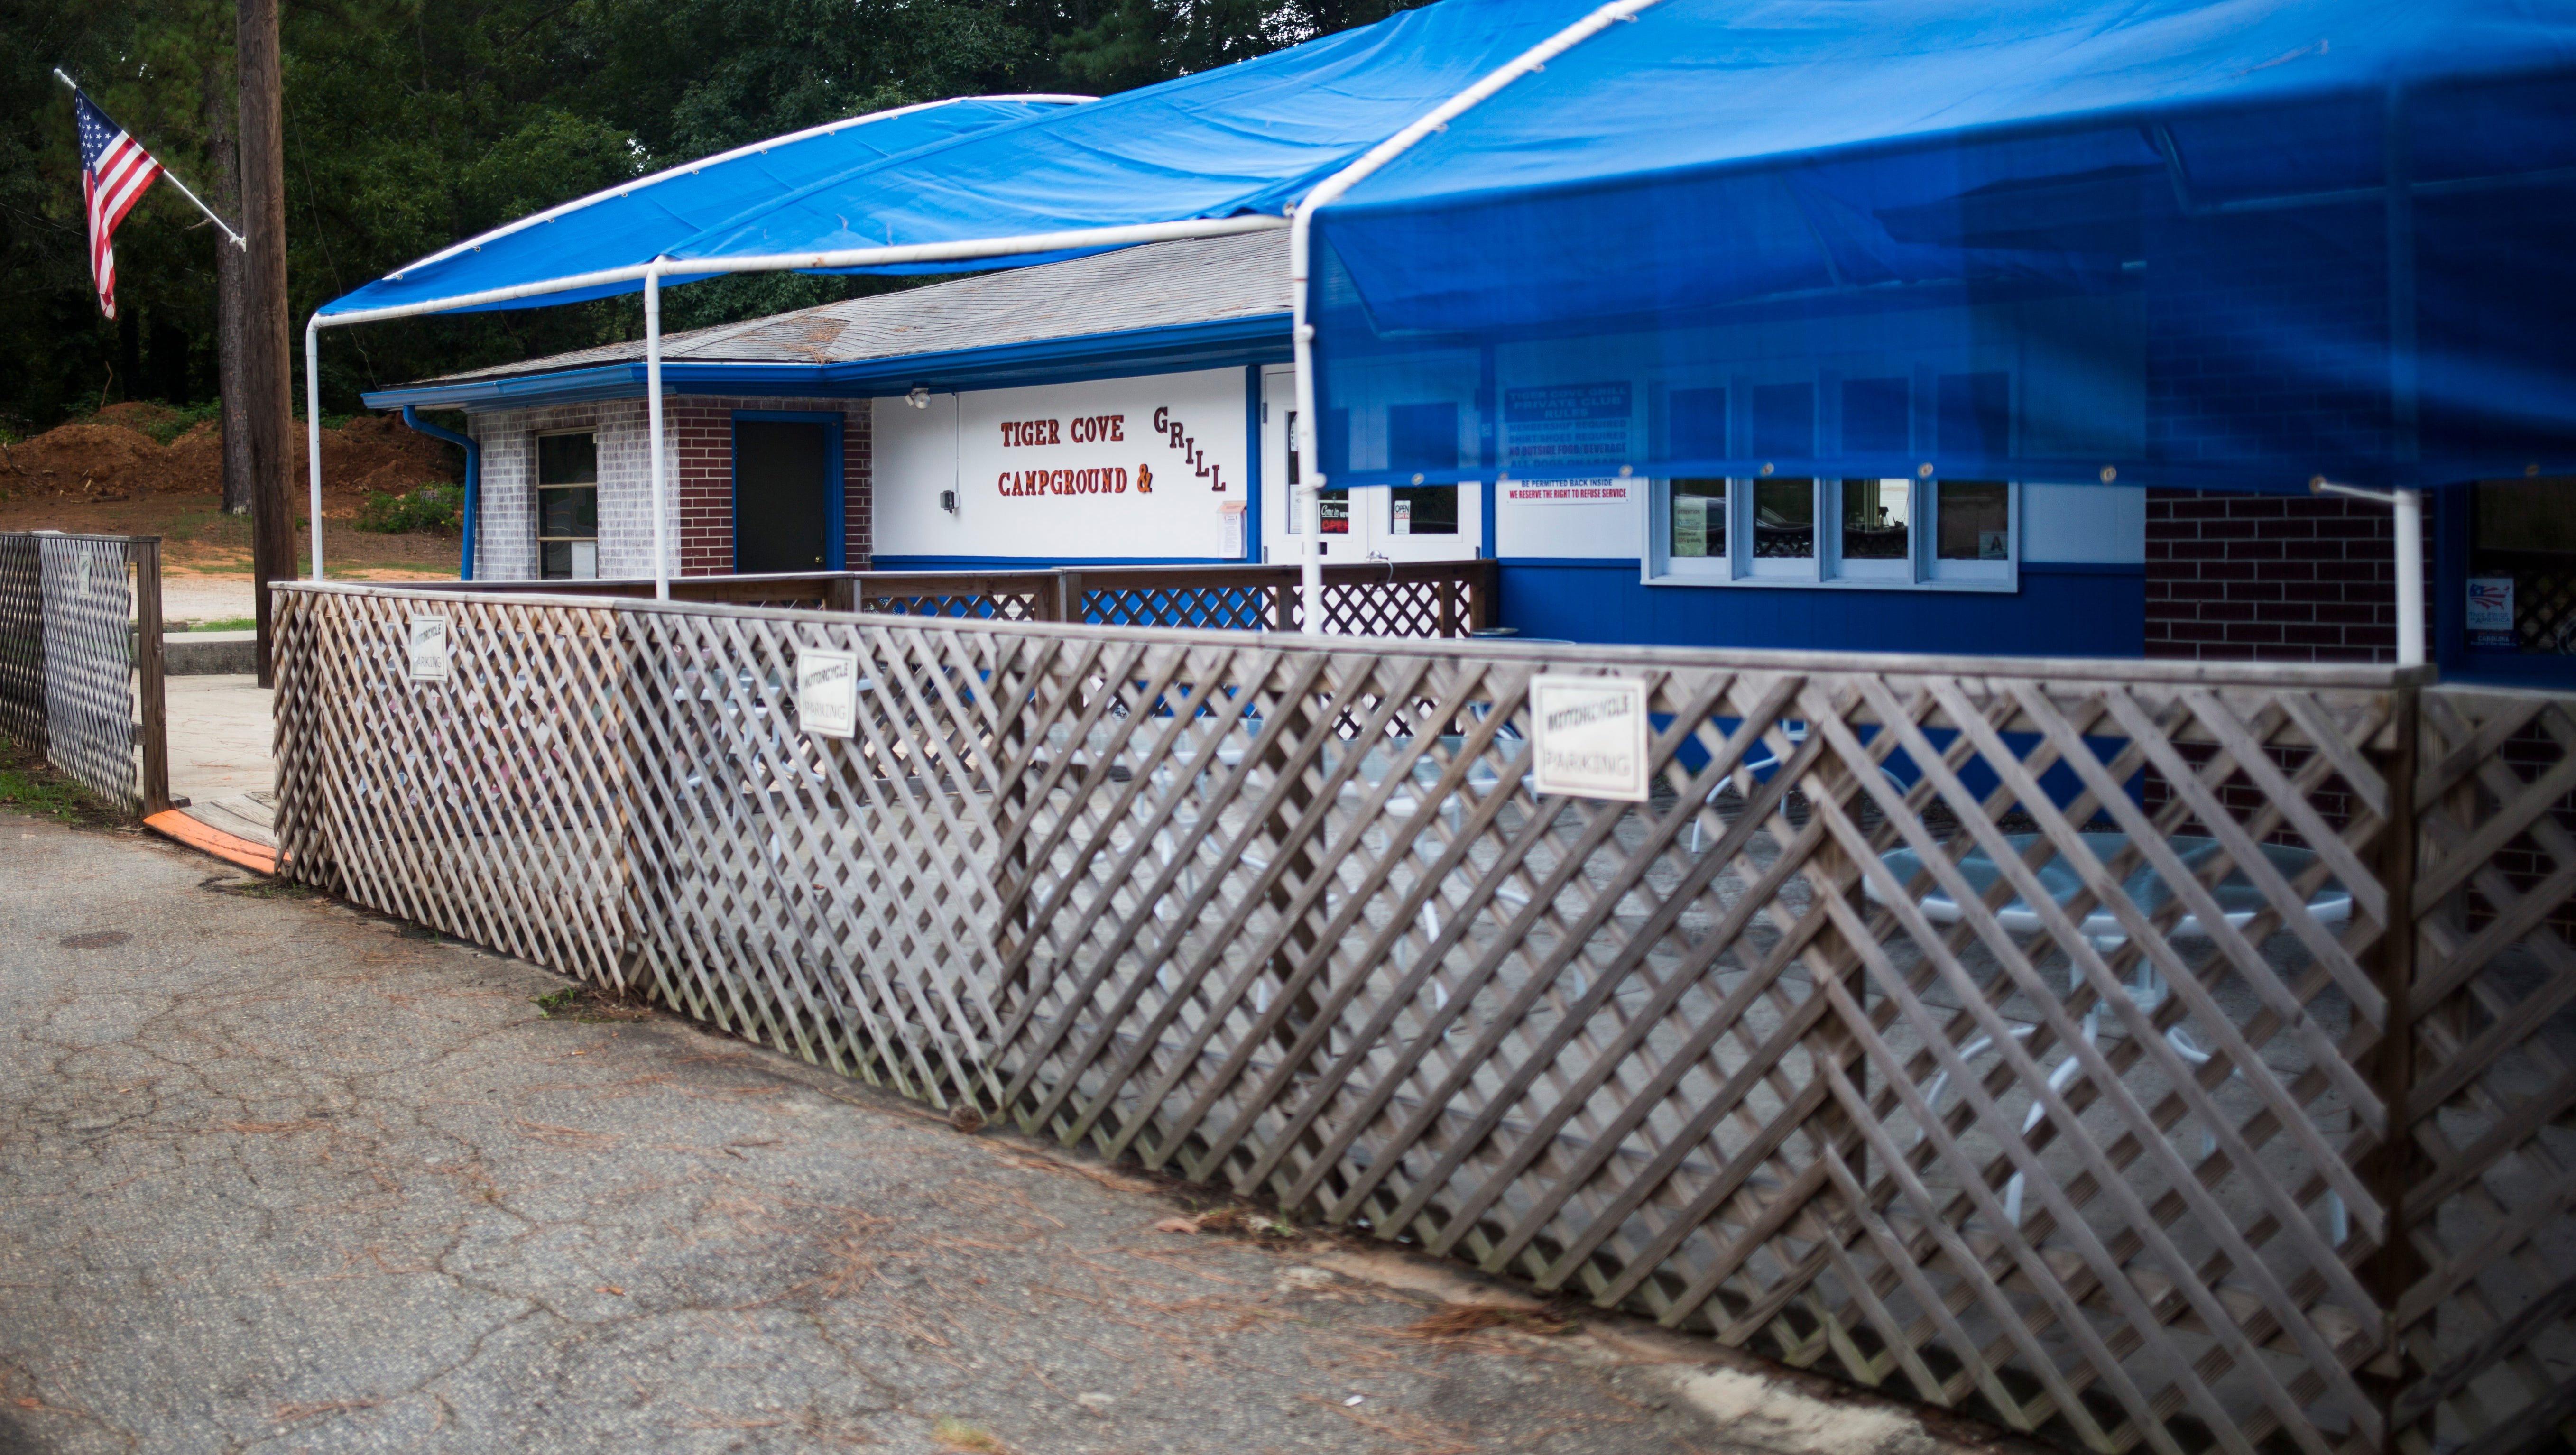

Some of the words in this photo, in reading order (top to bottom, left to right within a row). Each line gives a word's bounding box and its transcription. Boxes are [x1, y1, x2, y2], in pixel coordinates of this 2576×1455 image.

[1550, 389, 1585, 398] COVE
[1588, 387, 1626, 396] GRILL
[1514, 399, 1577, 410] PRIVATE
[1580, 396, 1622, 406] CLUB
[1544, 408, 1589, 418] RULES
[1001, 419, 1061, 447] TIGER
[1070, 414, 1125, 443] COVE
[1575, 420, 1626, 429] REQUIRED
[1575, 432, 1626, 442] REQUIRED
[1154, 407, 1226, 491] GRILL
[998, 467, 1127, 496] CAMPGROUND
[1137, 463, 1153, 493] &
[1509, 490, 1518, 499] WE
[1519, 489, 1542, 499] RESERVE
[1543, 489, 1552, 498] THE
[1554, 489, 1570, 498] RIGHT
[1572, 489, 1579, 498] TO
[1580, 489, 1601, 498] REFUSE
[1602, 488, 1626, 498] SERVICE
[1395, 505, 1410, 513] OPEN
[1991, 535, 2003, 551] A
[416, 655, 441, 668] ARKING
[803, 662, 849, 690] MOTORCYCLE
[804, 701, 846, 720] PARKING
